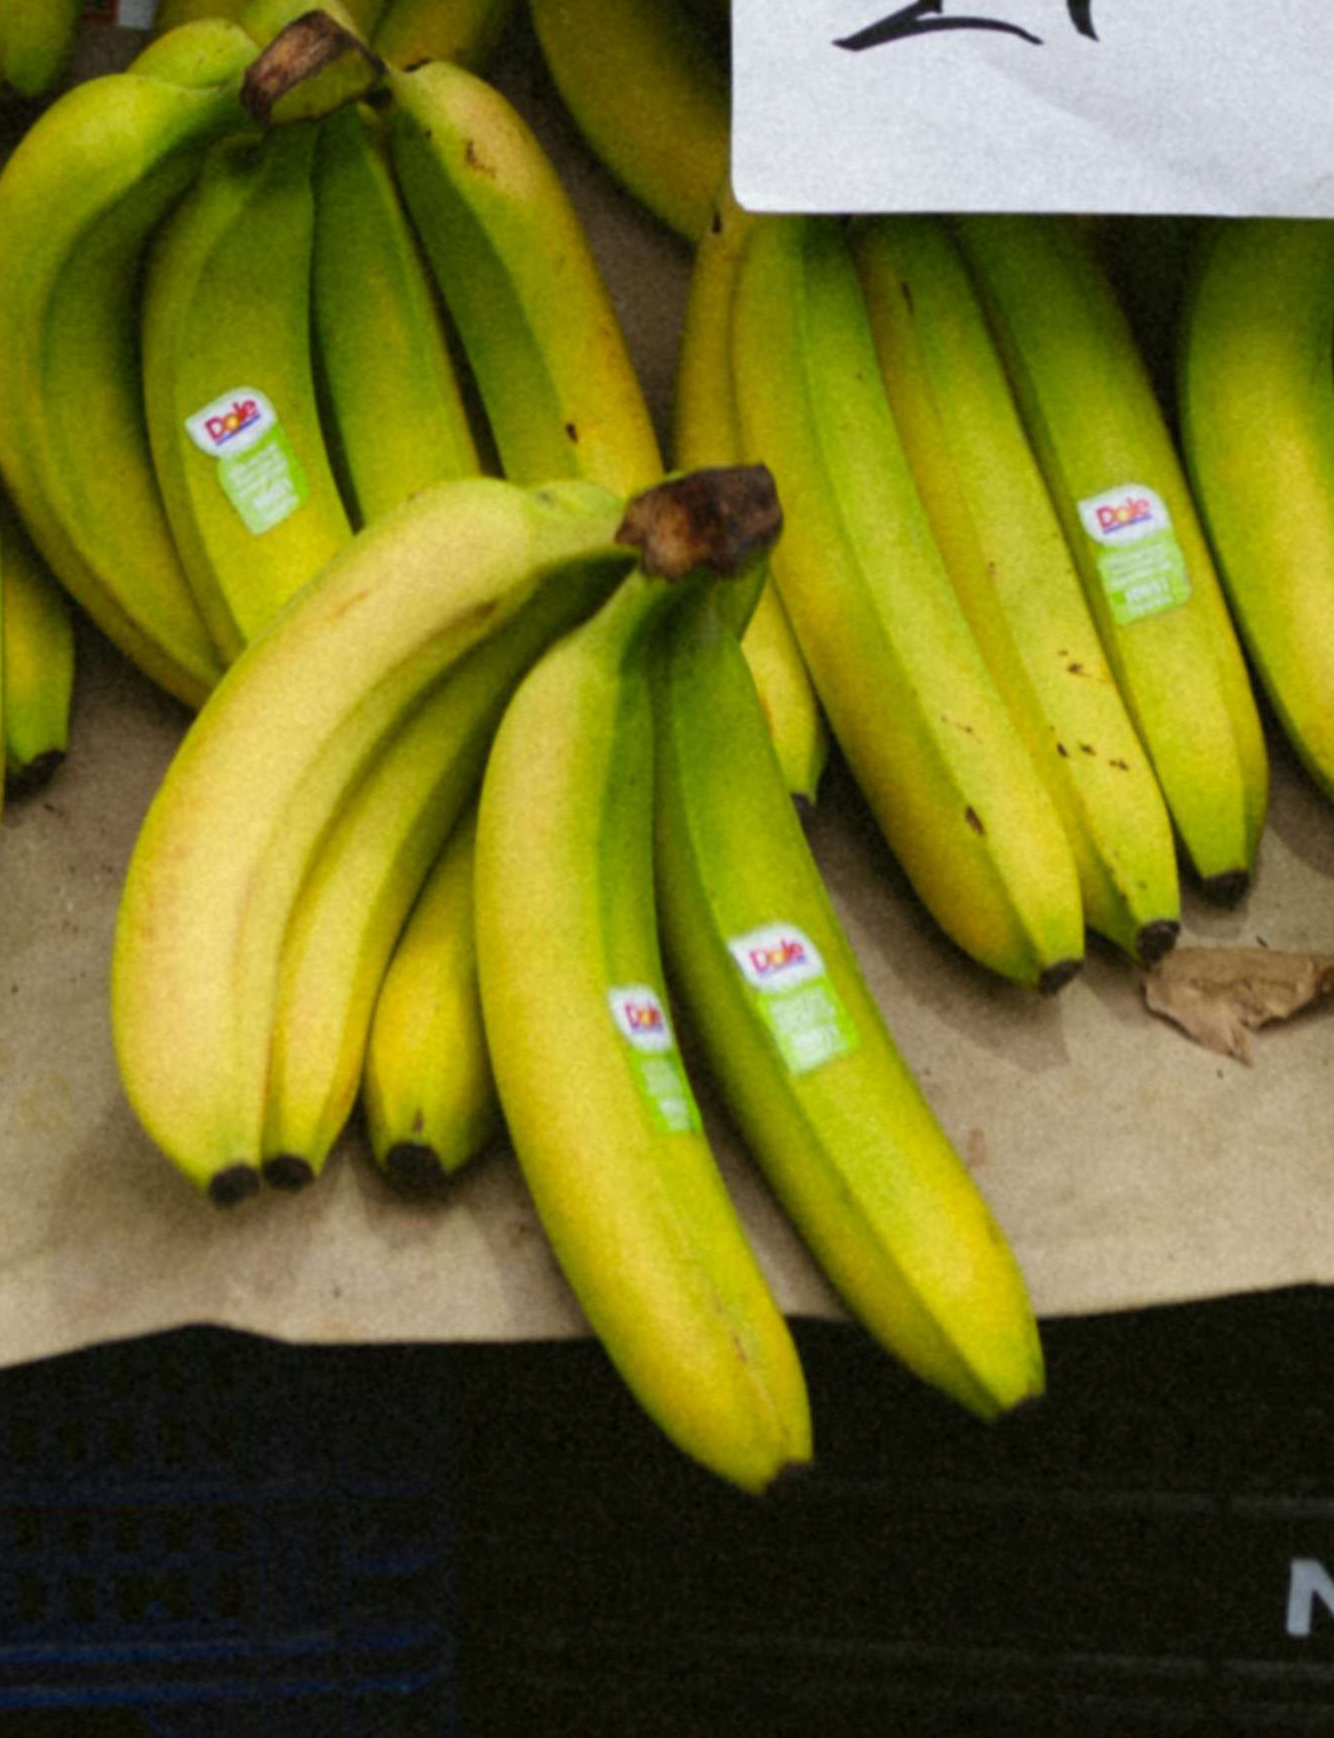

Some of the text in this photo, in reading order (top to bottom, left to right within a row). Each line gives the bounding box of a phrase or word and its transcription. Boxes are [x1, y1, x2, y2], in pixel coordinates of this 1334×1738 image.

[204, 399, 257, 441] Dole
[1096, 497, 1150, 529] Dole
[750, 937, 806, 974] Dole
